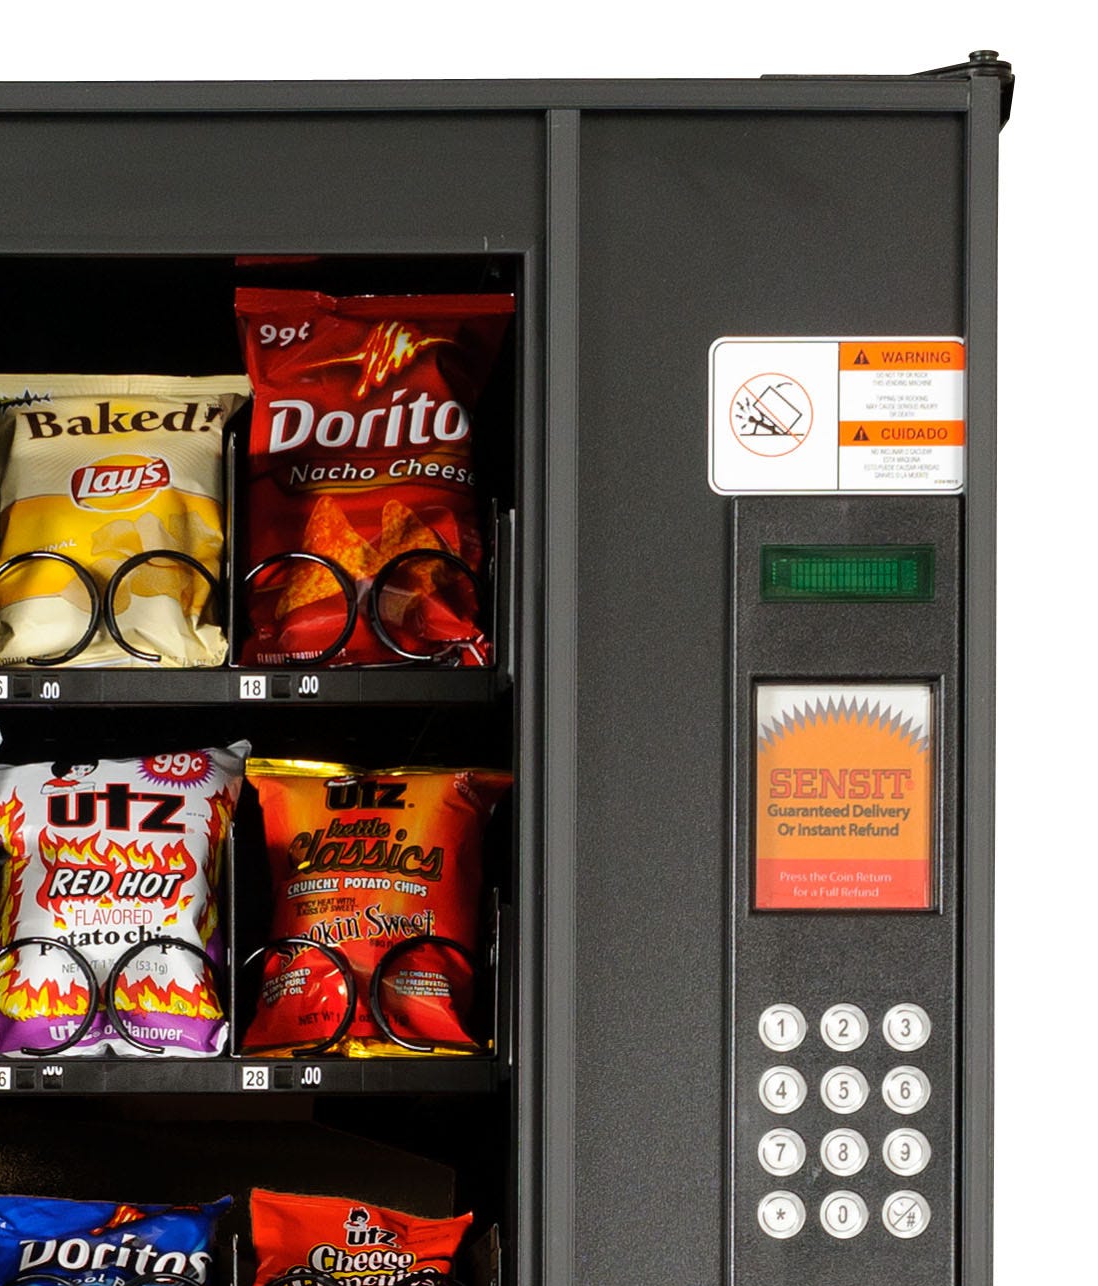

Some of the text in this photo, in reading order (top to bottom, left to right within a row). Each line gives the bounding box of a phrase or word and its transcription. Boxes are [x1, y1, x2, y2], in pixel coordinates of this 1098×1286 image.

[260, 321, 311, 347] 99¢
[881, 351, 951, 364] WARNING
[22, 402, 223, 440] Baked!
[880, 427, 948, 440] CUIDADO
[289, 462, 376, 486] Nacho
[40, 682, 60, 699] .00
[243, 681, 261, 696] 18
[769, 768, 911, 799] SENSIT
[767, 803, 910, 821] Guaranteed Delivery
[777, 823, 899, 837] Or Instant Refund
[289, 830, 444, 881] Classics
[50, 868, 182, 897] RED HOT
[287, 877, 427, 897] CRUNCHY POTATO CHIPS
[779, 872, 892, 883] Press the Coin Return
[793, 886, 879, 898] for a Full Refund
[74, 909, 152, 925] FLAVORED
[364, 903, 436, 938] Sweet
[776, 1018, 786, 1038] 1
[838, 1018, 849, 1037] 2
[900, 1018, 911, 1037] 3
[246, 1071, 265, 1087] 28
[775, 1080, 787, 1100] 4
[838, 1081, 849, 1100] 5
[900, 1080, 911, 1100] 6
[776, 1143, 786, 1162] 7
[838, 1142, 848, 1162] 8
[900, 1142, 911, 1162] 9
[838, 1205, 847, 1224] 0
[310, 1246, 413, 1272] Cheese
